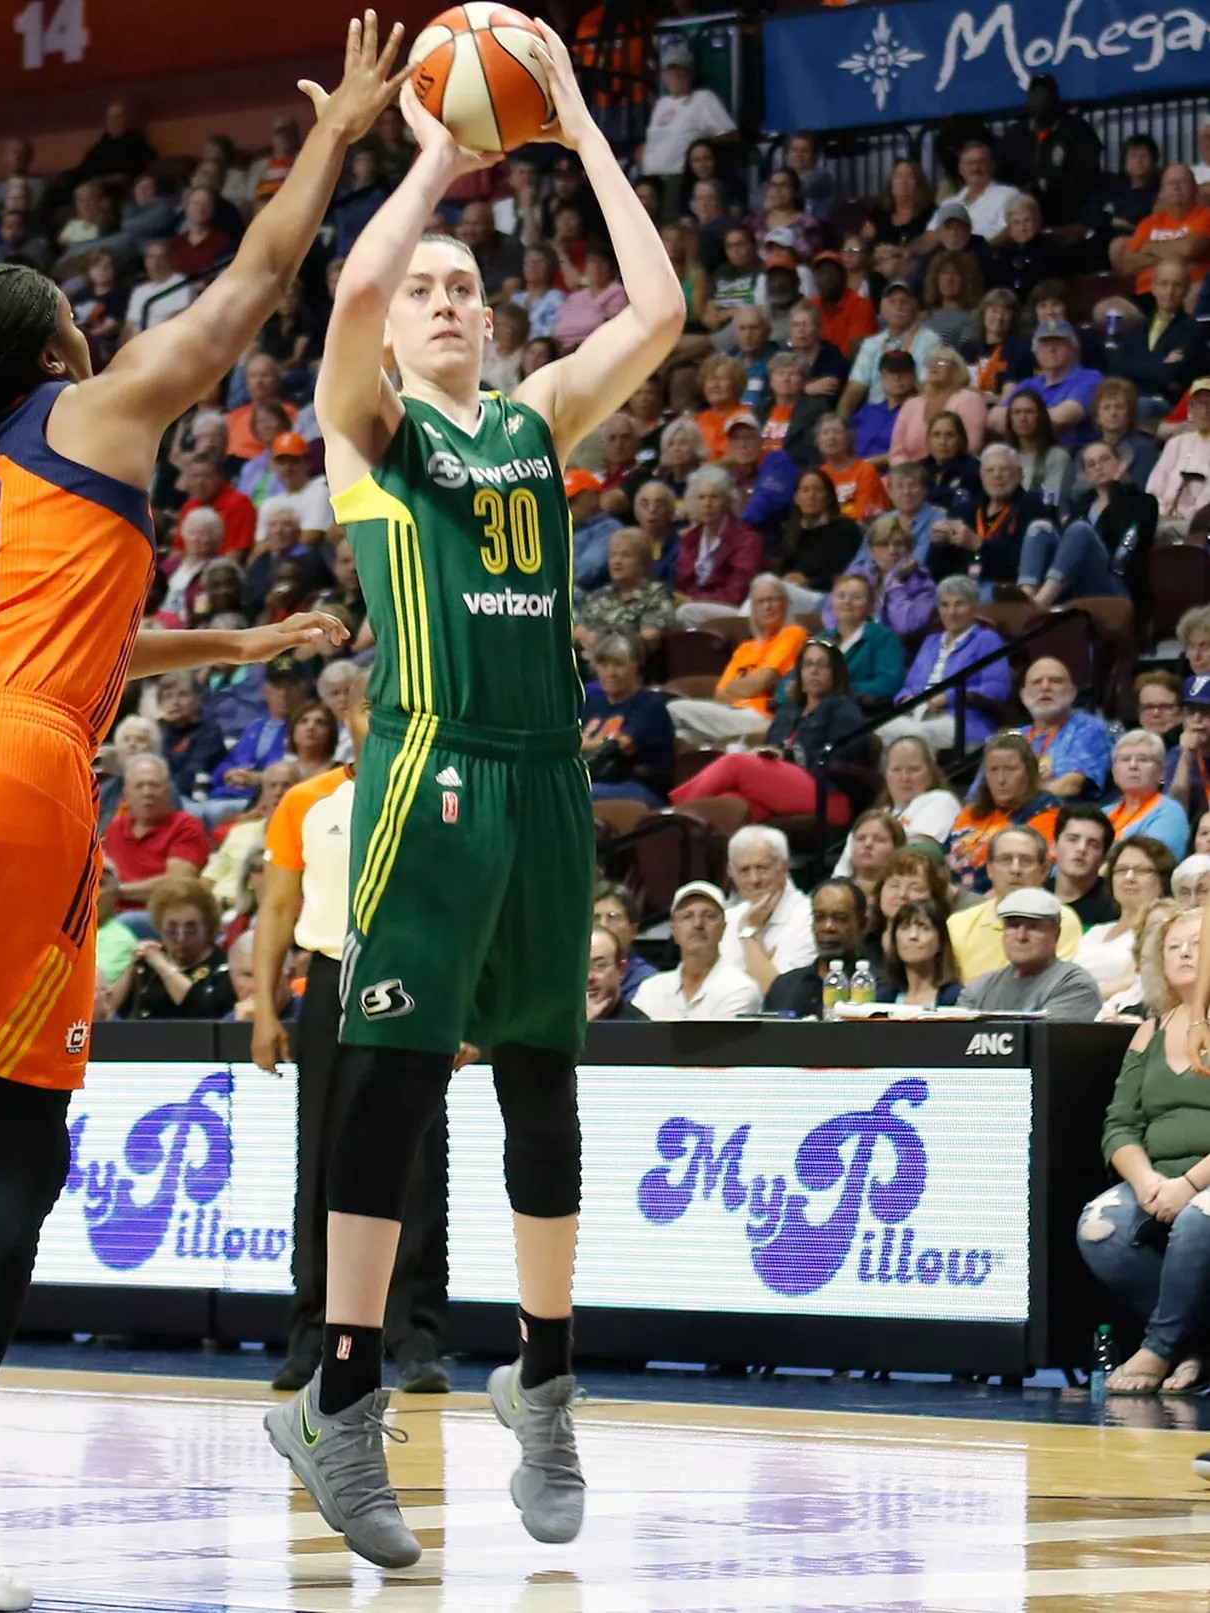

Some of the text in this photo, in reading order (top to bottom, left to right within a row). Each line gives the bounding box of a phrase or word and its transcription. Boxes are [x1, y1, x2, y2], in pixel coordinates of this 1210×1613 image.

[13, 0, 90, 69] 14
[934, 0, 1210, 92] Mohega
[473, 487, 542, 575] 30
[463, 587, 557, 618] verizon
[965, 1033, 1014, 1056] ANC
